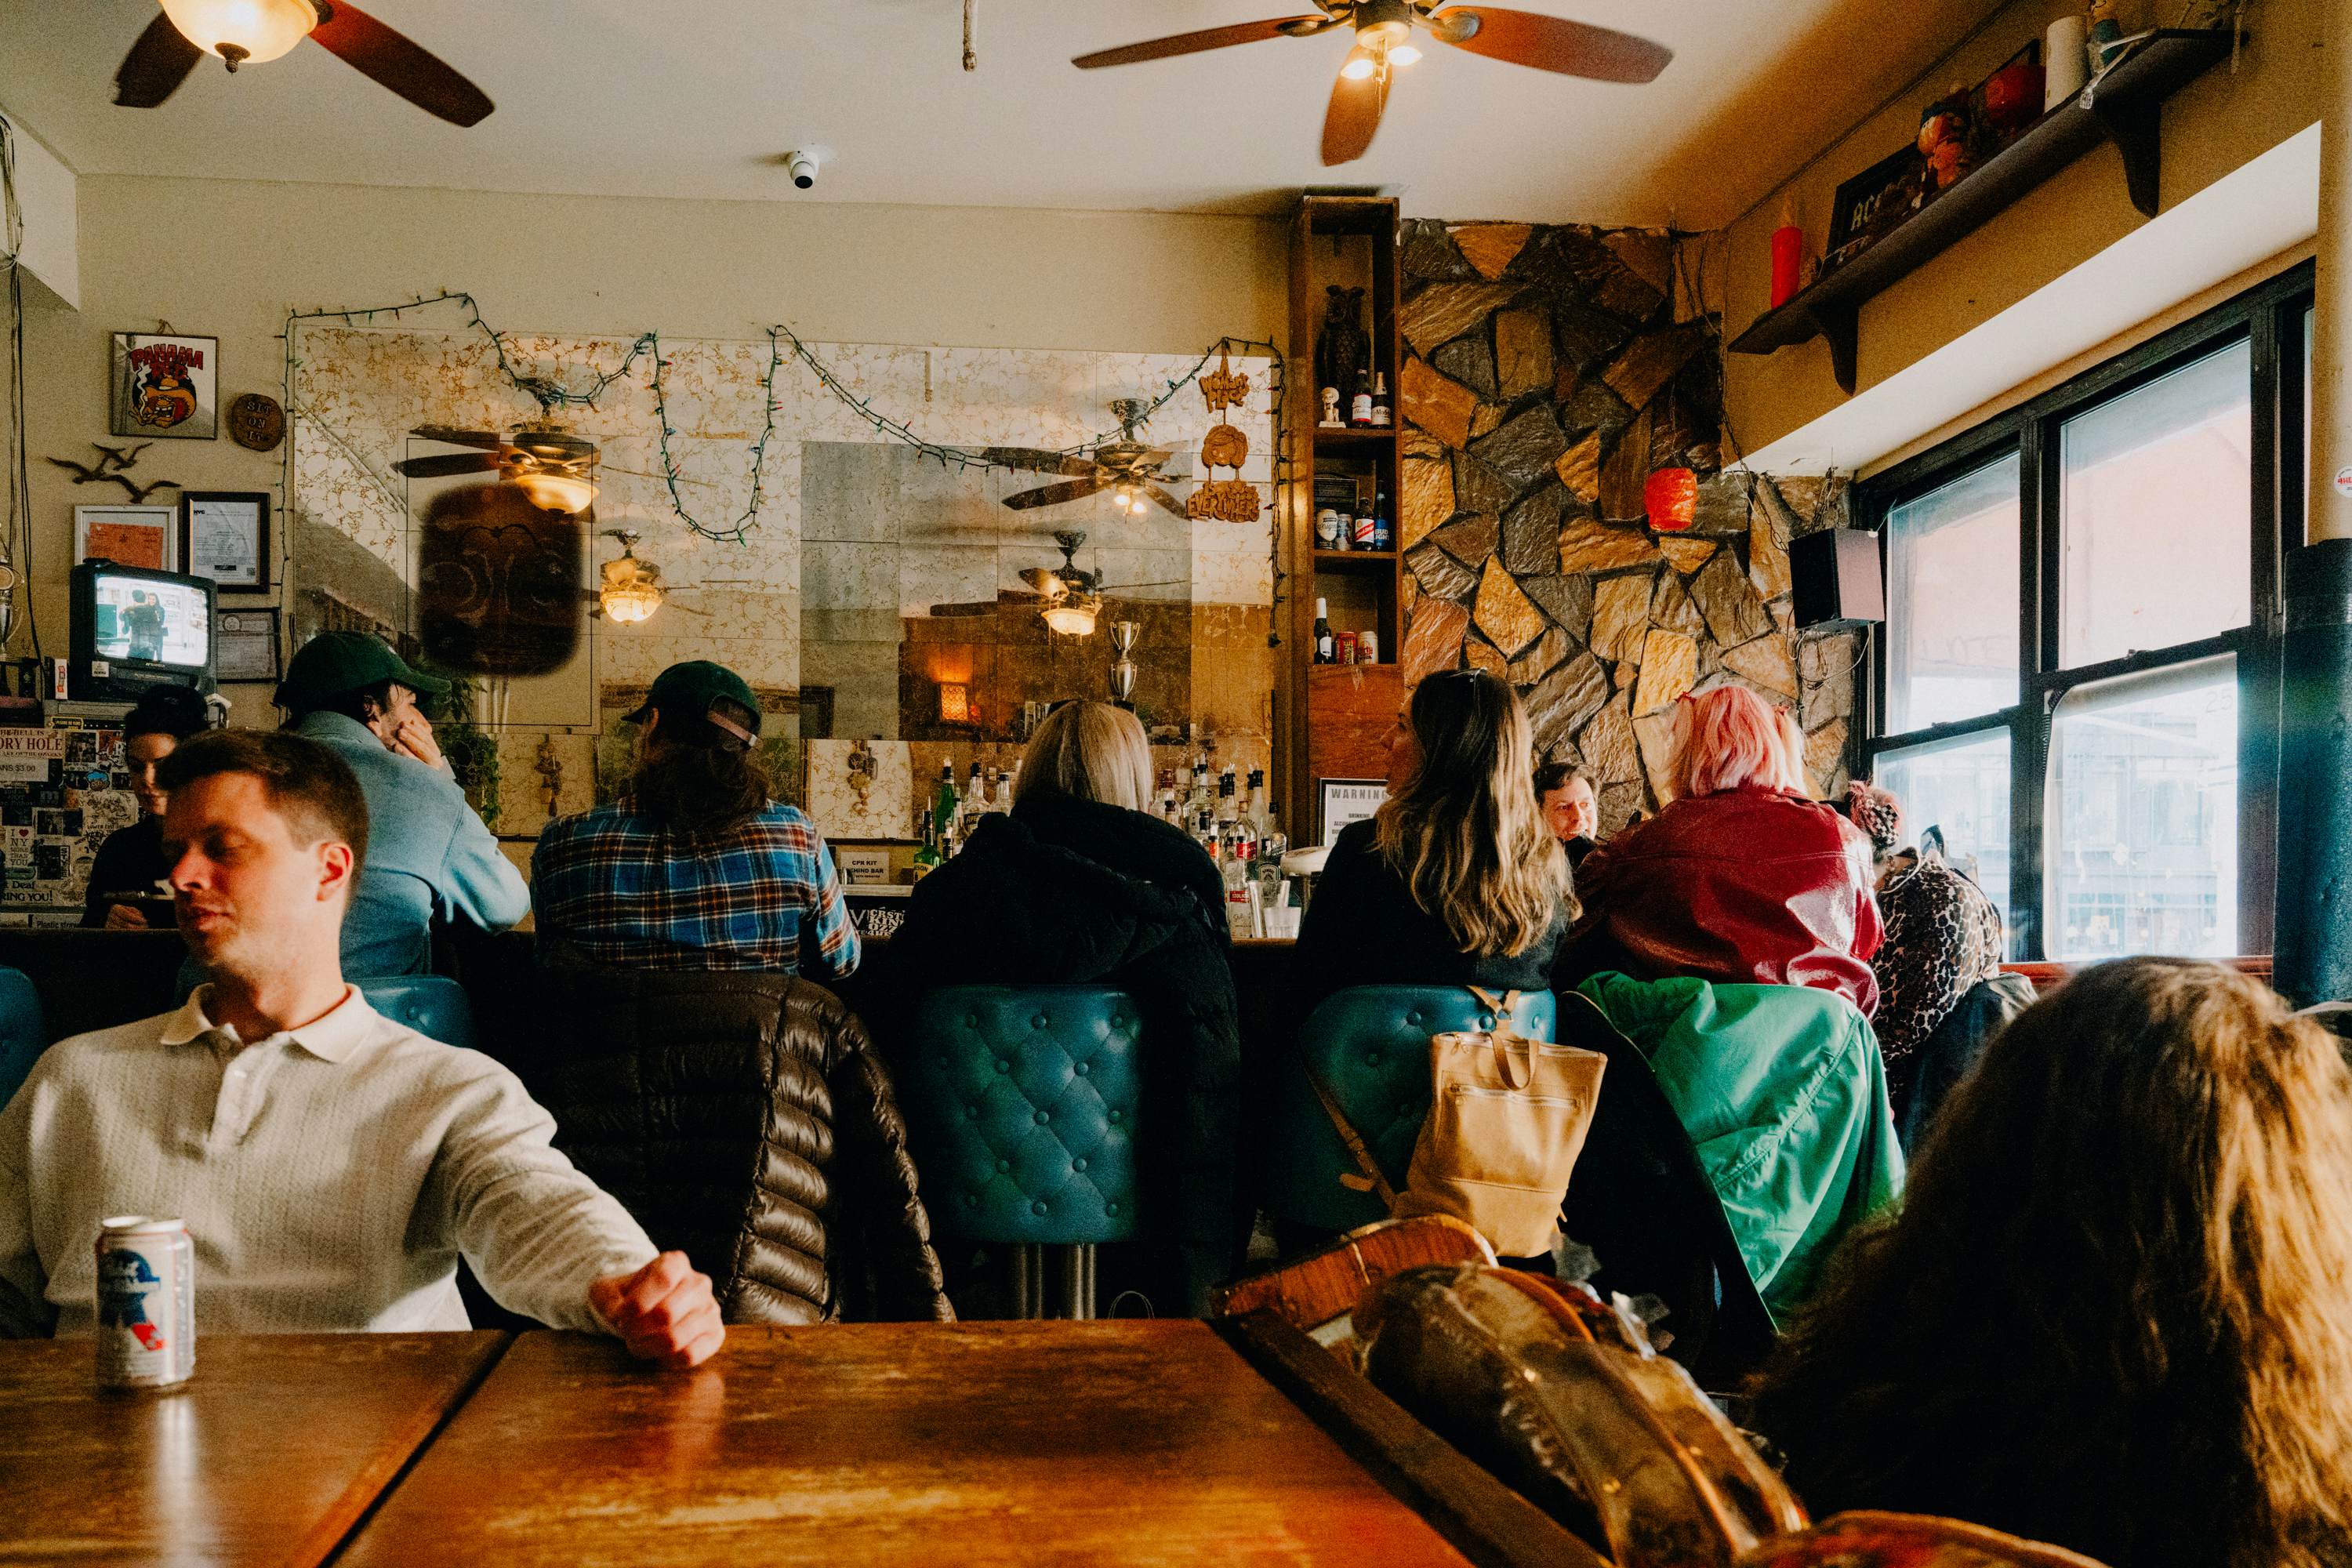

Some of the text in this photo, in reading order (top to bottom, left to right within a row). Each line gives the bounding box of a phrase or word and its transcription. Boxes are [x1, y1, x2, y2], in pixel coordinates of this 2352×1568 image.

[130, 343, 203, 372] PANAMA
[247, 401, 271, 414] SIT
[249, 419, 266, 428] ON
[249, 432, 265, 441] IT
[27, 738, 63, 750] HOLE
[11, 838, 28, 847] NY
[27, 891, 53, 902] YOU!
